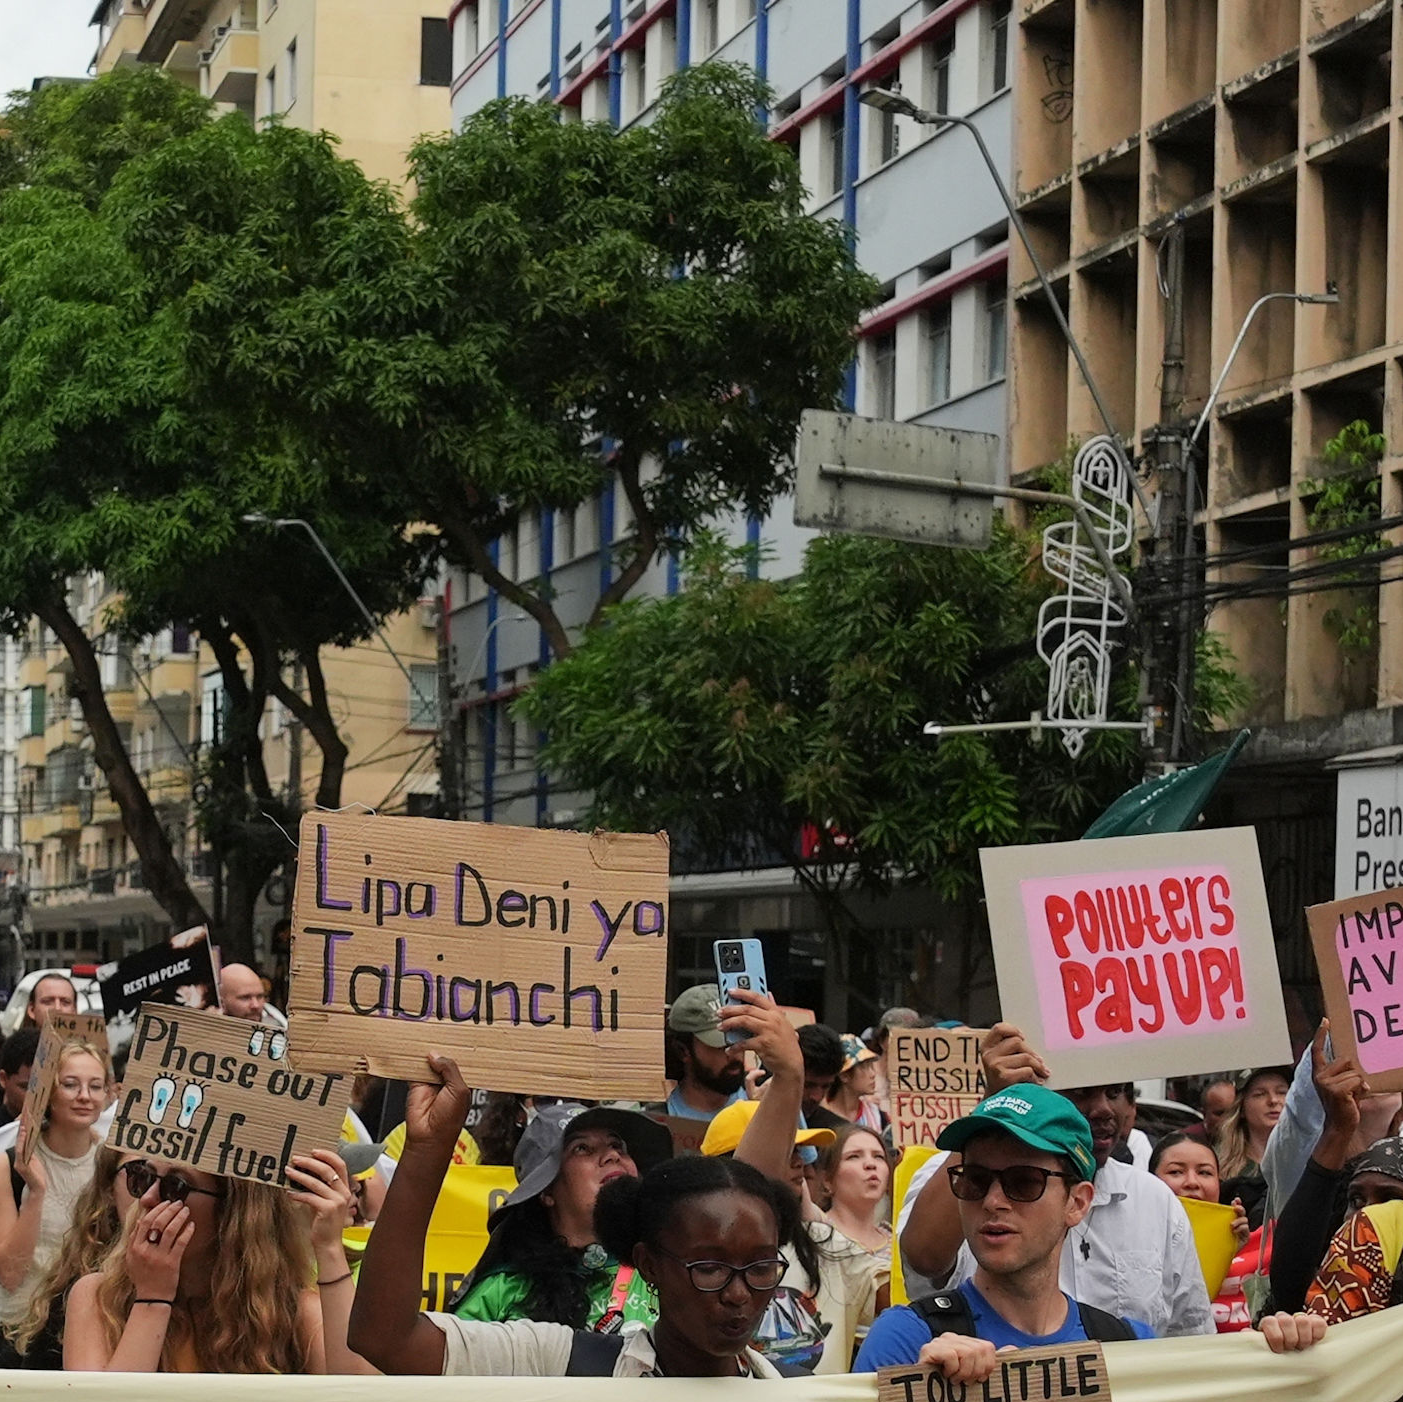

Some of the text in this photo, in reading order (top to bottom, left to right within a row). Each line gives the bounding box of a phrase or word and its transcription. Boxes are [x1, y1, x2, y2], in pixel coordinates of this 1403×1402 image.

[315, 823, 665, 962] Lipa Deni ya
[122, 957, 191, 997] REST IN PEACE
[304, 926, 619, 1033] Tabianchi
[1162, 947, 1246, 1026] UP!
[134, 1014, 258, 1090] Phase
[897, 1036, 950, 1063] END
[1353, 1004, 1402, 1045] DE
[115, 1089, 218, 1165] fossil
[218, 1112, 297, 1185] fuel
